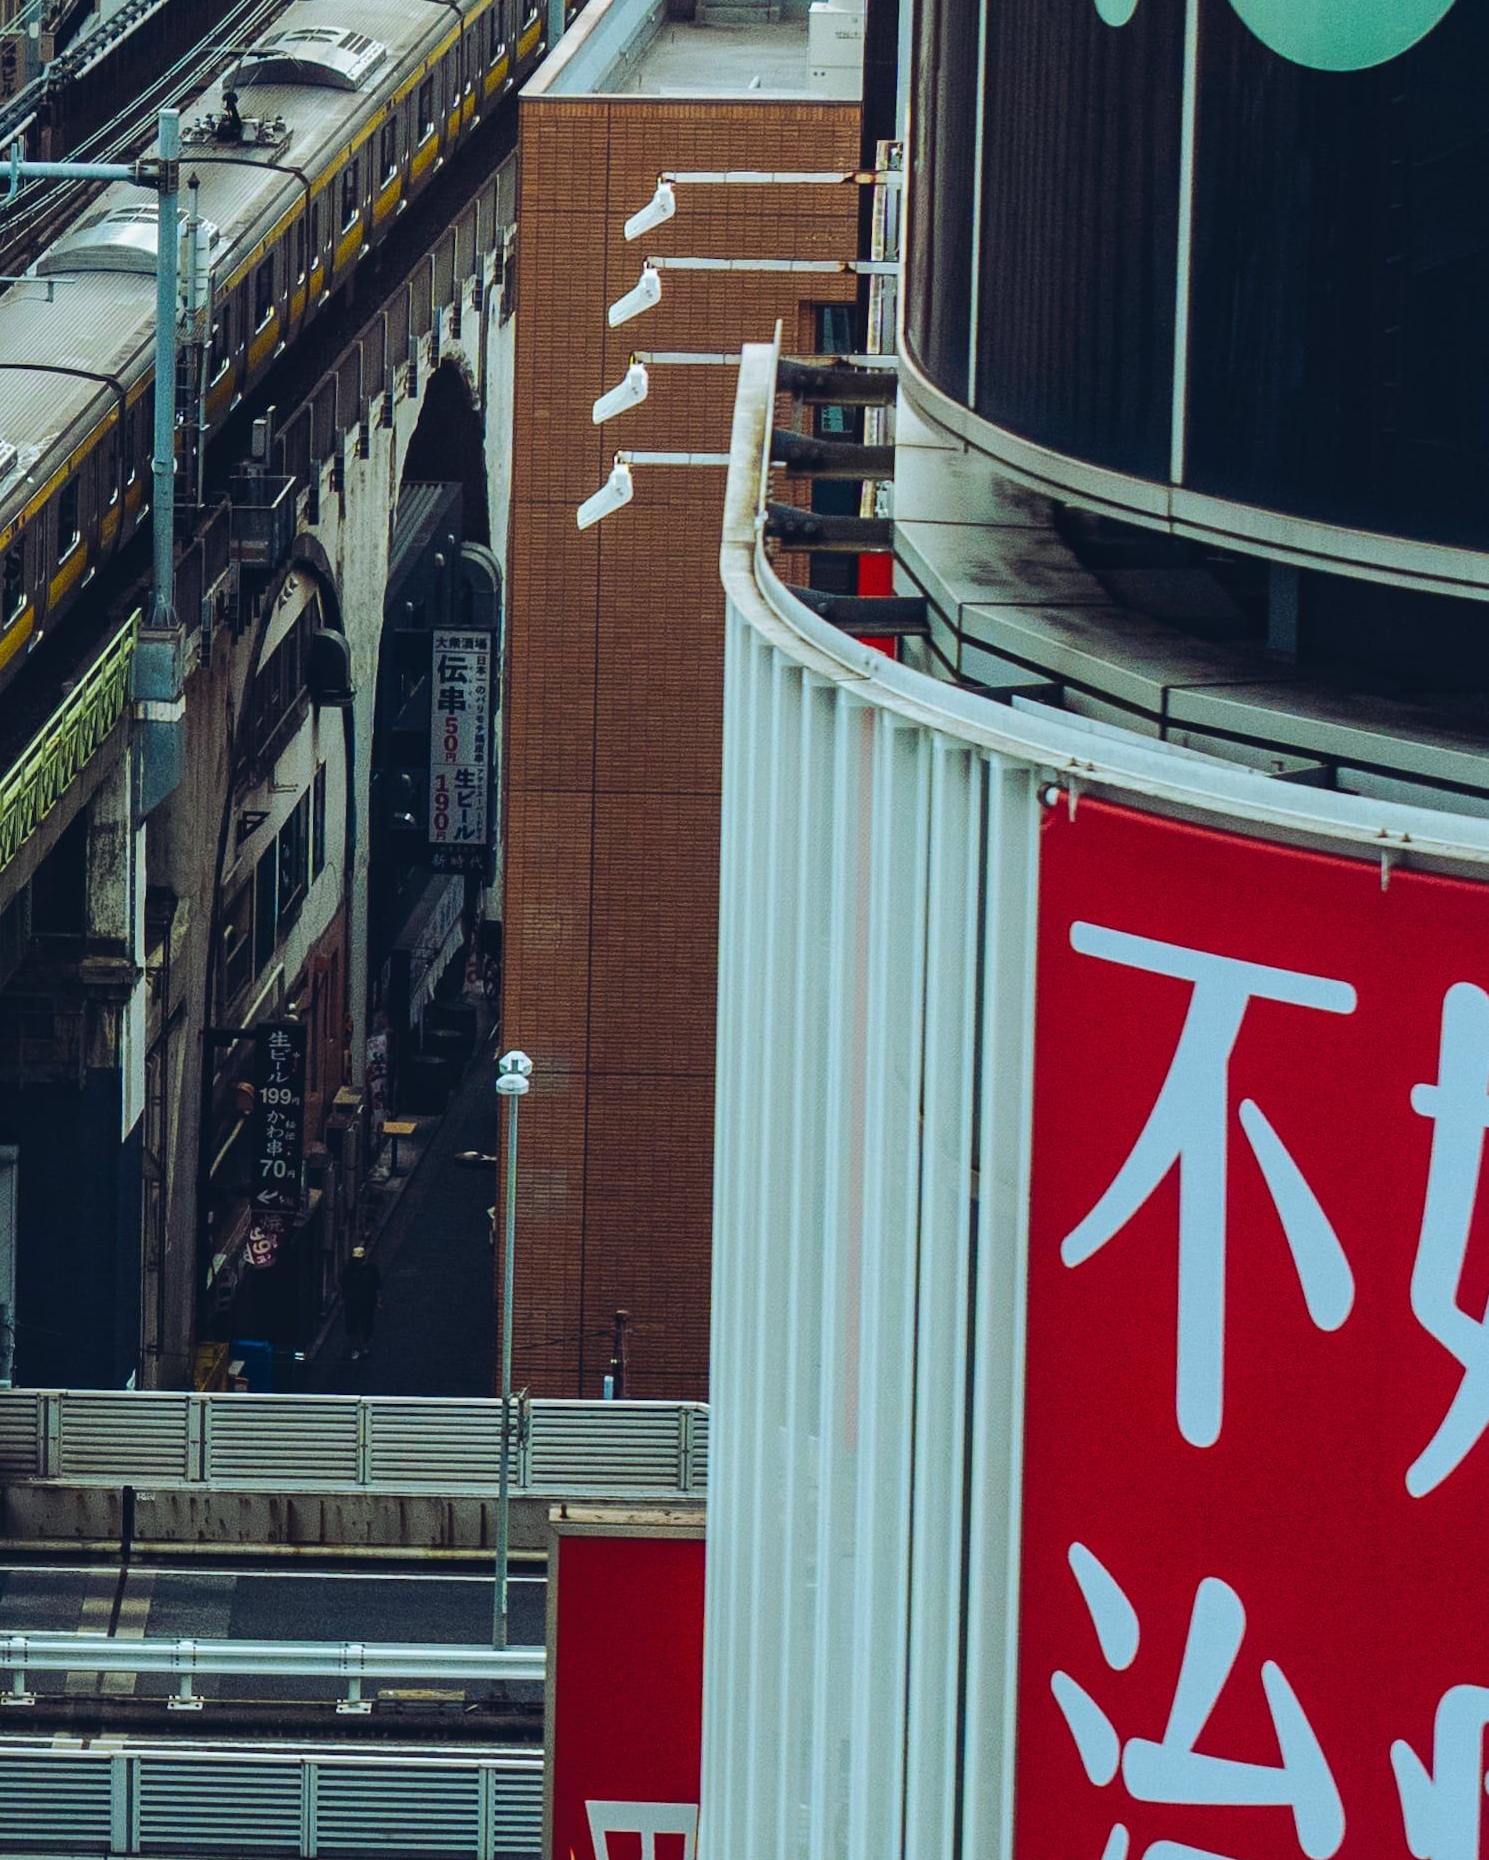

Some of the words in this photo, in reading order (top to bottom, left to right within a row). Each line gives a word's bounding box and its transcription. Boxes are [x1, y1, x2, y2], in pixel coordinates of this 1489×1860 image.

[453, 767, 476, 841] 生ビール
[267, 1030, 292, 1083] 生ビール
